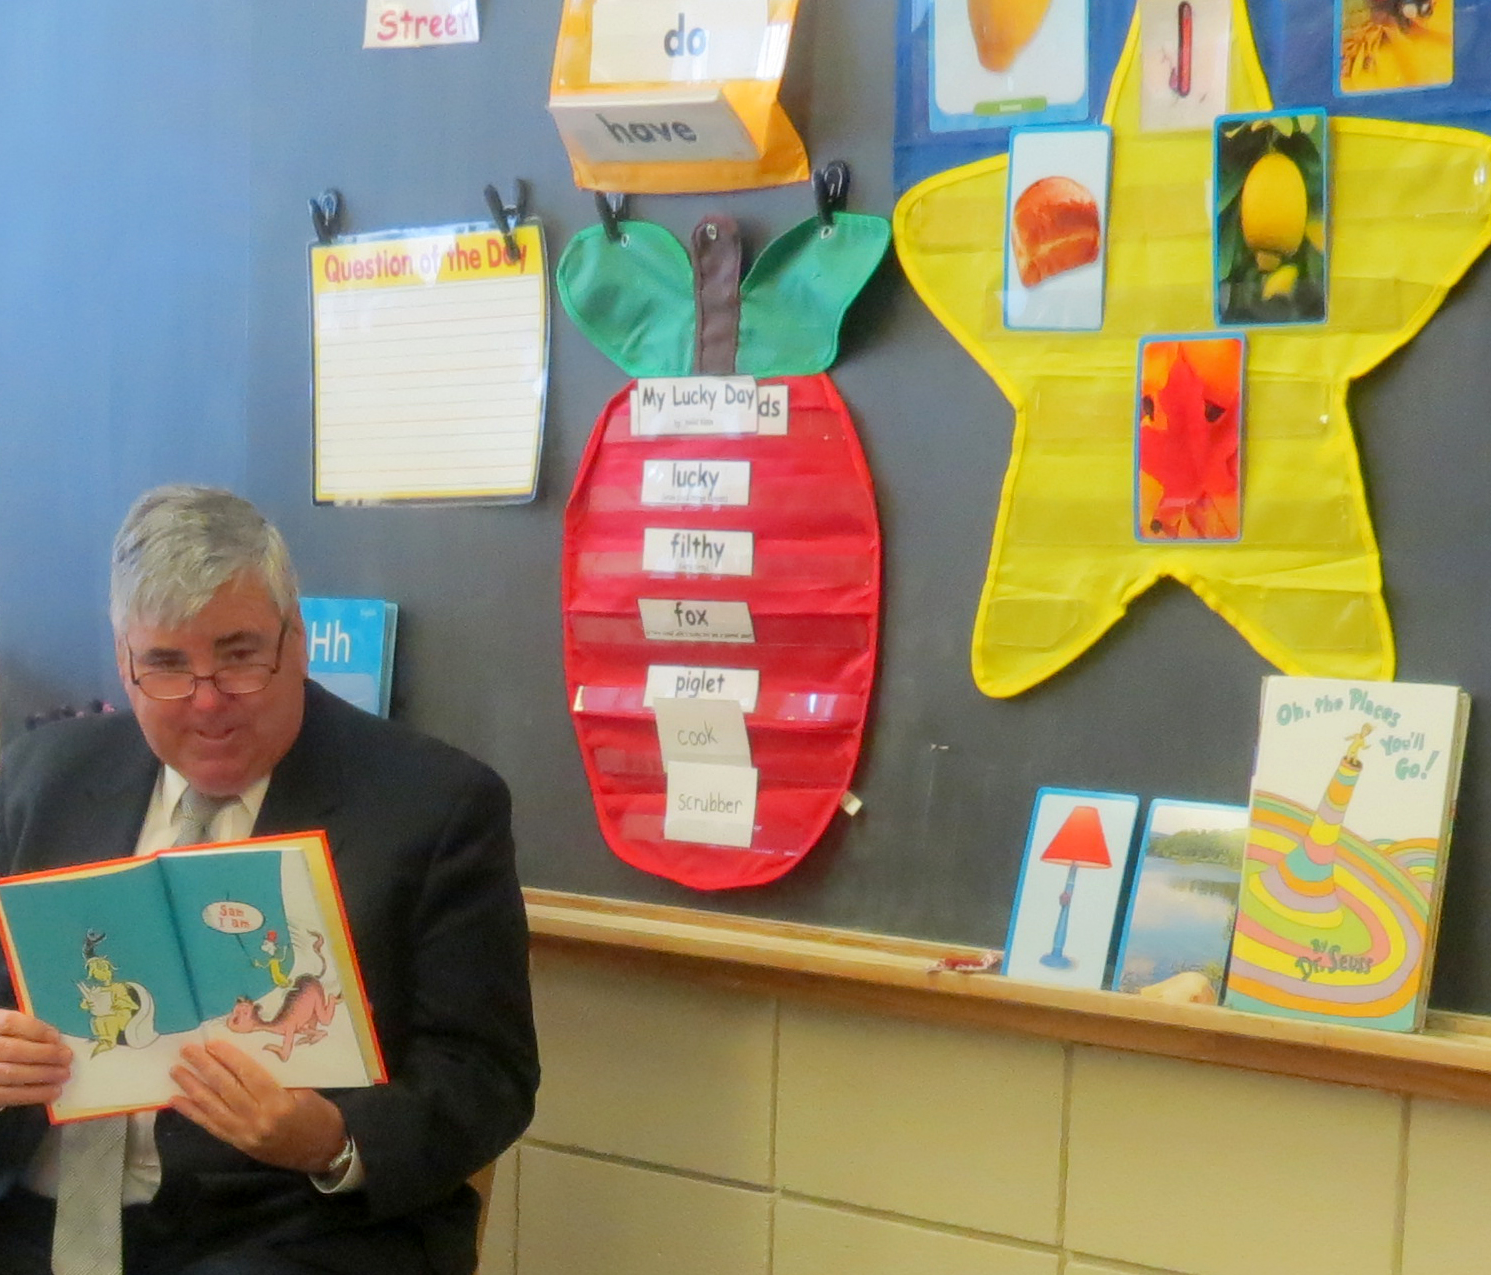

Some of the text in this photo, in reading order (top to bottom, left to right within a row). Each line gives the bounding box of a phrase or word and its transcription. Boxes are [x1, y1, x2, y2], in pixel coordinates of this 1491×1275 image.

[377, 9, 470, 41] Street
[664, 12, 707, 58] do
[595, 112, 697, 144] have
[324, 249, 414, 285] Question
[419, 244, 440, 275] of
[447, 241, 482, 271] the
[642, 383, 755, 412] My Lucky Day
[672, 463, 719, 495] lucky
[671, 532, 725, 567] filthy
[674, 602, 708, 627] fox
[310, 619, 351, 663] Hh
[675, 671, 725, 698] piglet
[1315, 695, 1344, 714] the
[1349, 688, 1401, 728] Places
[677, 721, 718, 746] cook
[1379, 731, 1425, 756] You'll
[1395, 750, 1440, 780] Go!
[677, 792, 743, 815] scrubber
[219, 904, 244, 917] Sam
[231, 919, 250, 929] am
